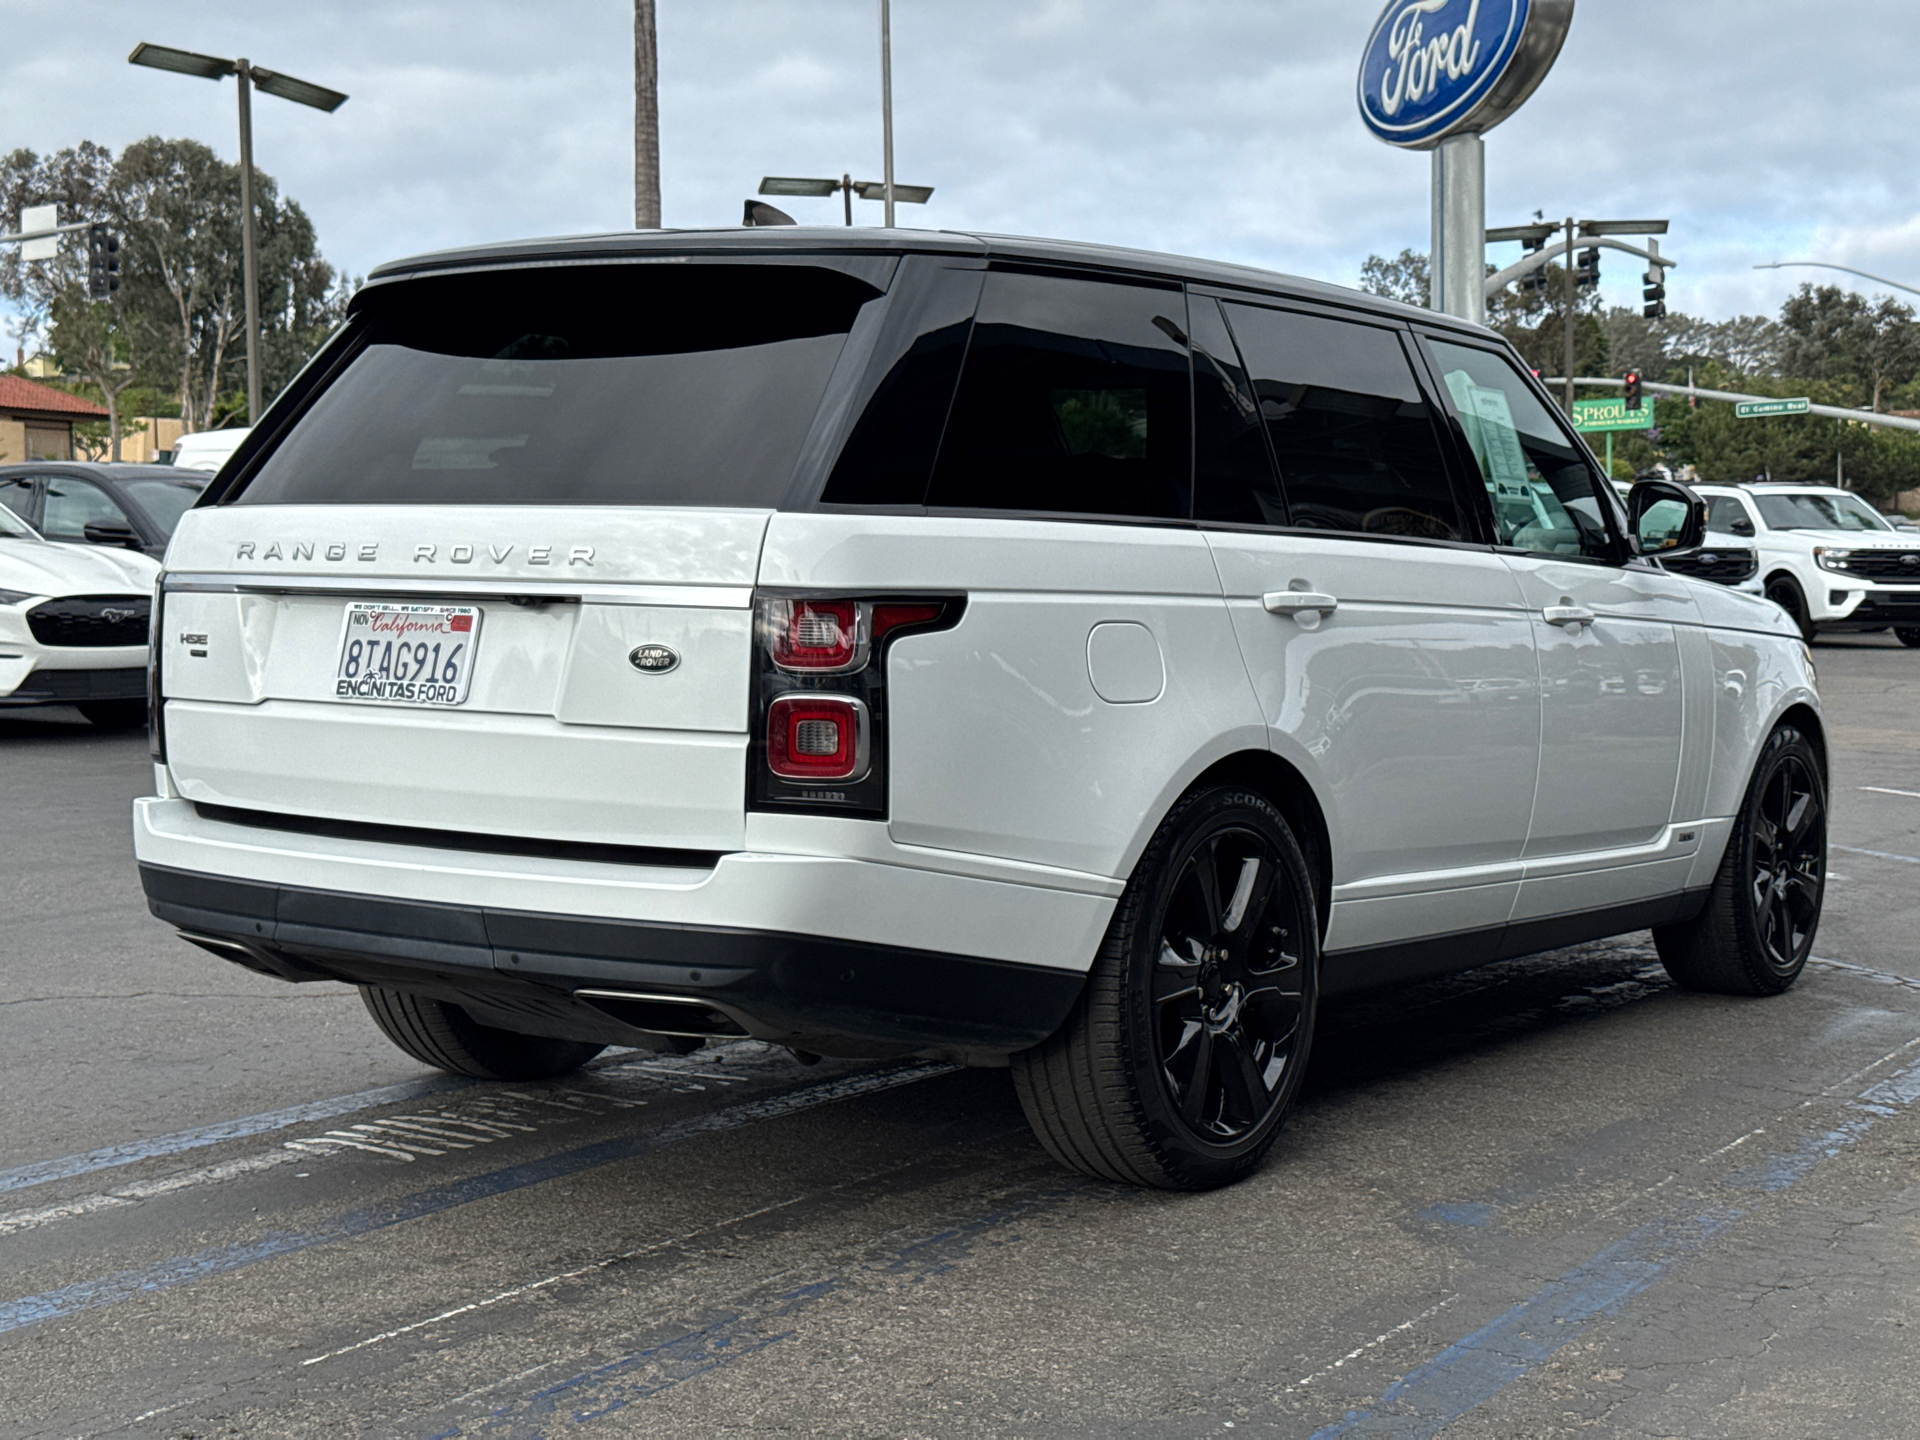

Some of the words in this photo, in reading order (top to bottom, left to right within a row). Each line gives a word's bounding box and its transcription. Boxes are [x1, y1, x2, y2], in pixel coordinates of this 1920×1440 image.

[1381, 0, 1481, 116] Ford
[235, 541, 380, 562] RANGE
[413, 543, 596, 567] ROVER
[371, 613, 453, 638] California
[180, 633, 209, 646] HSE
[345, 638, 464, 685] 8TAG916
[638, 649, 663, 658] LAND
[640, 657, 671, 667] ROVER
[336, 679, 416, 700] ENCINITAS
[417, 683, 457, 702] FORD
